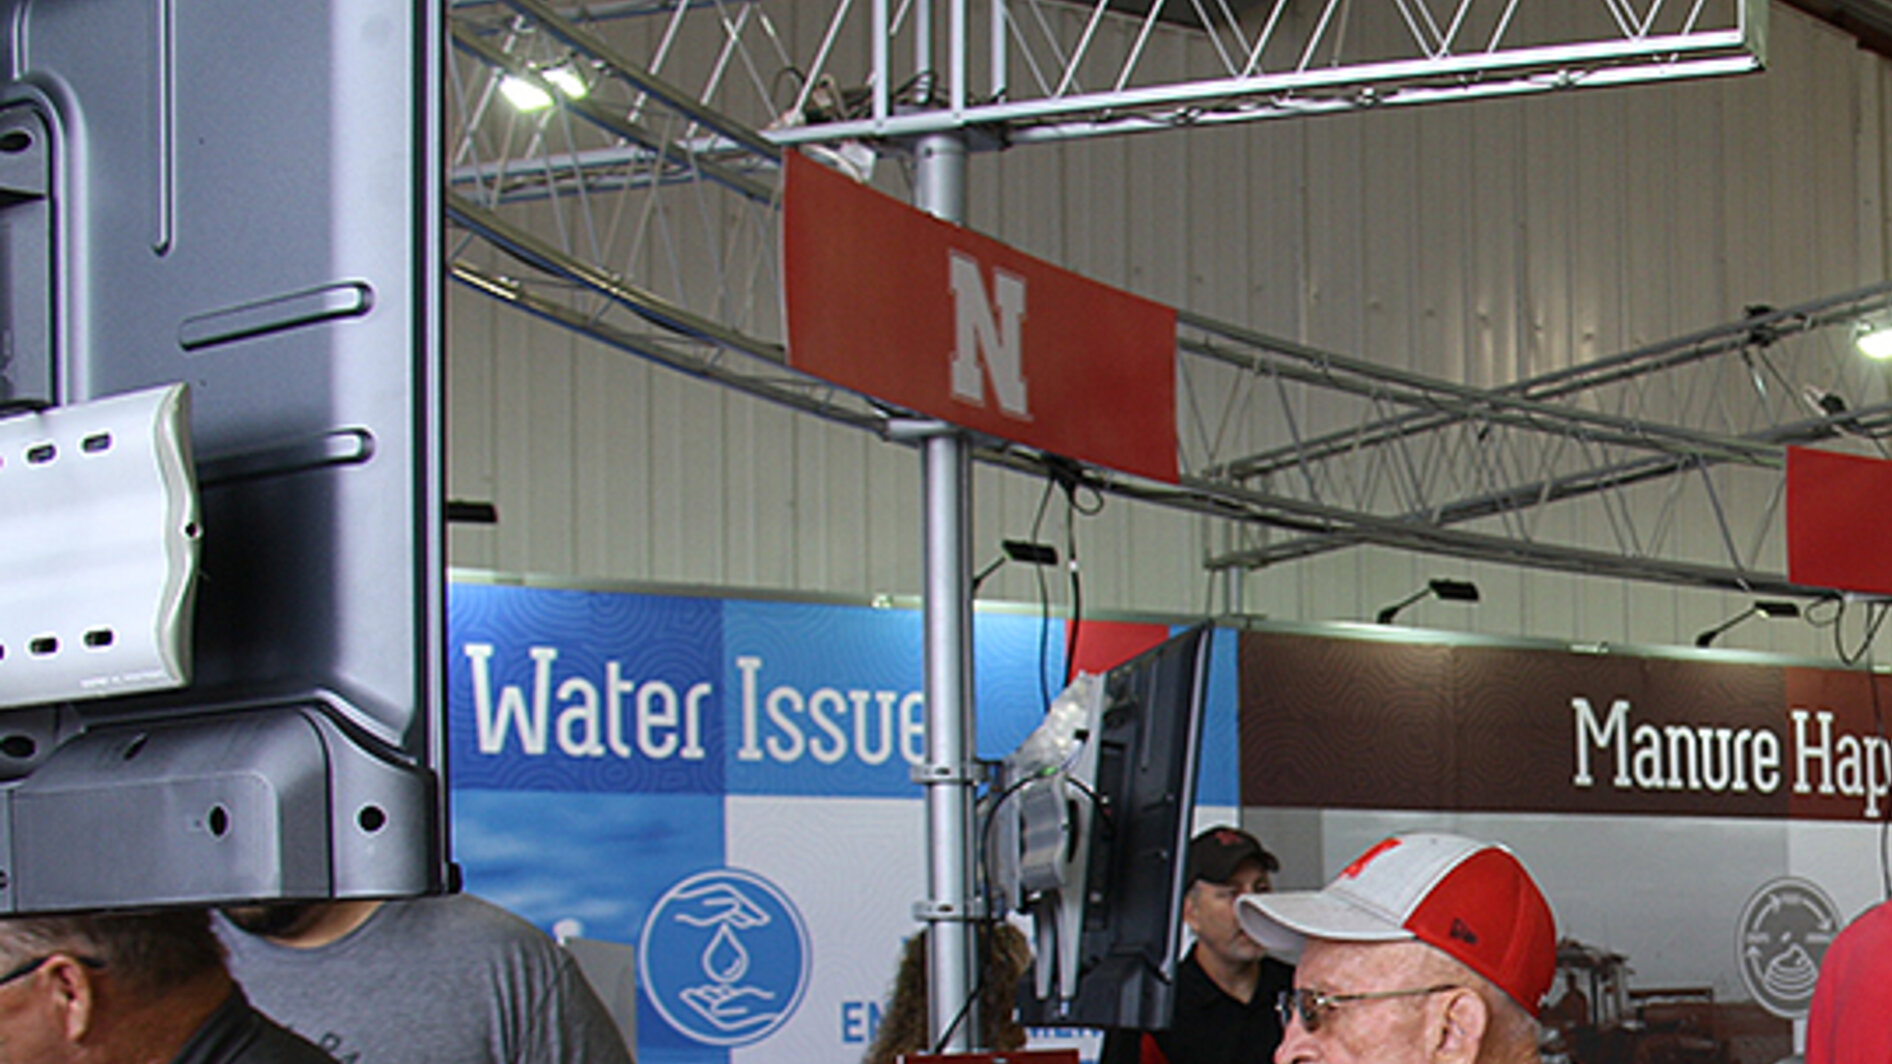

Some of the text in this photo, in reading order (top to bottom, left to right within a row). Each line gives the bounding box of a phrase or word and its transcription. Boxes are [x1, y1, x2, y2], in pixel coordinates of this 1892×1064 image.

[947, 248, 1033, 421] N
[463, 643, 925, 766] Water Issue
[1571, 697, 1781, 793] Manure
